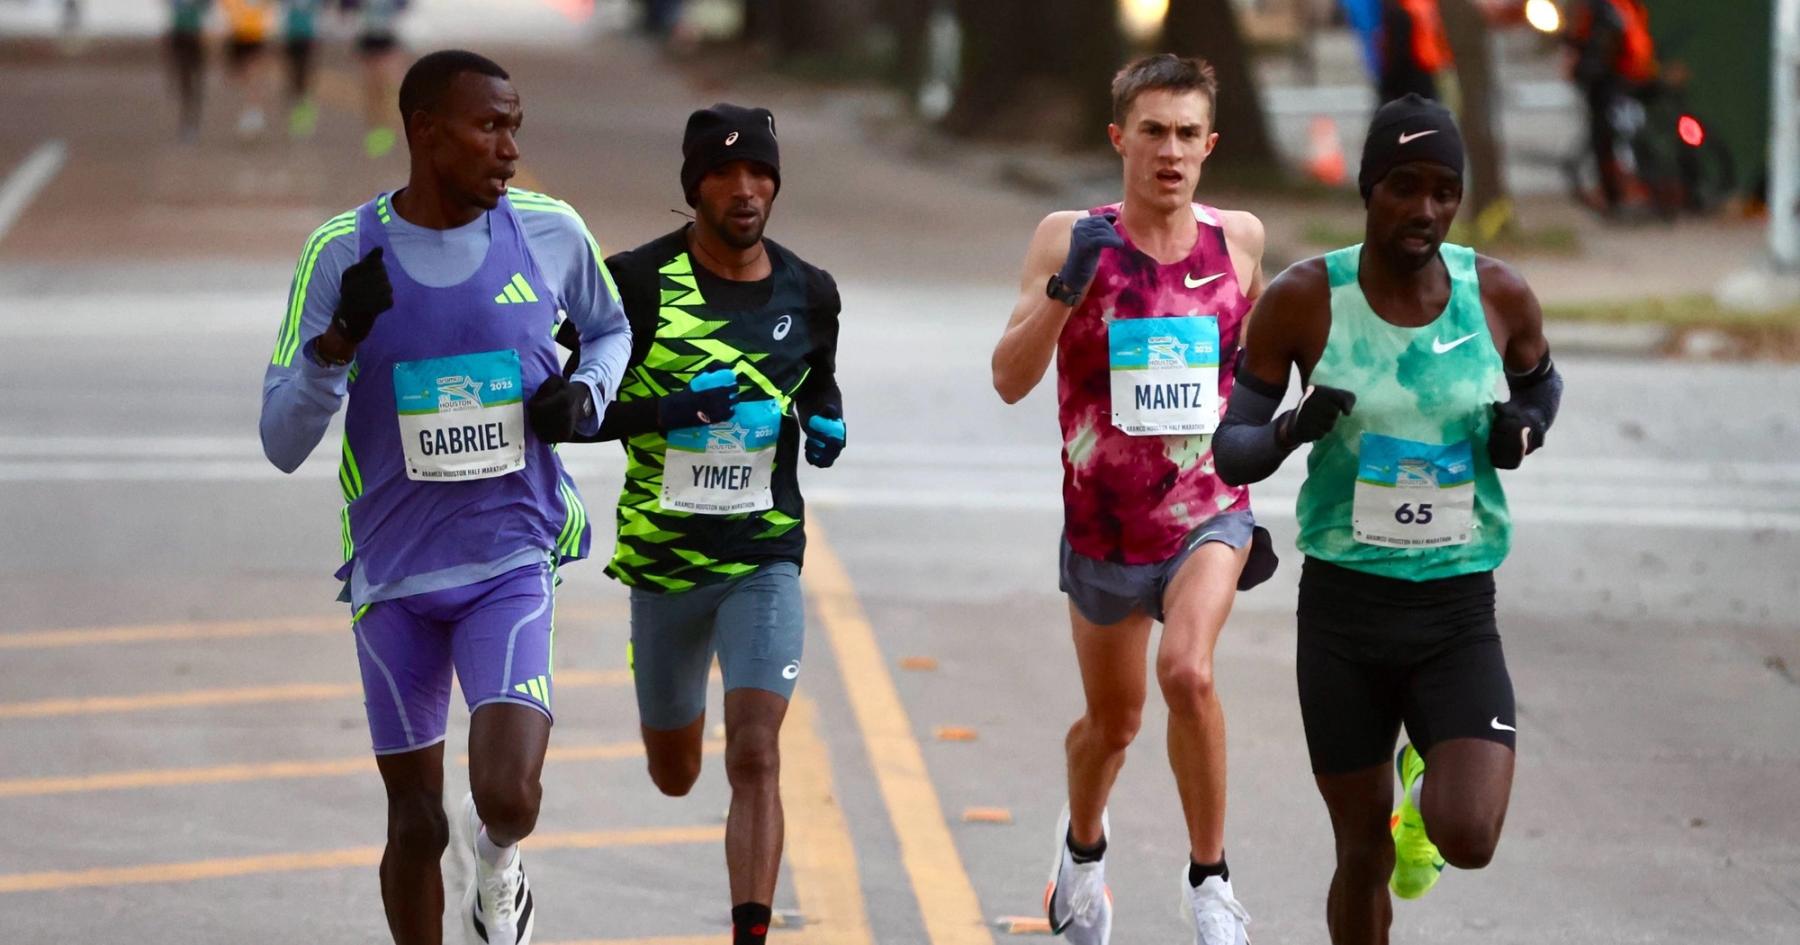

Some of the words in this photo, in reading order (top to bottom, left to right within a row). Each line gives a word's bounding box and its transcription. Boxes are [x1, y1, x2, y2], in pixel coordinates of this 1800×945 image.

[490, 381, 513, 392] 2025
[1135, 383, 1202, 410] MANTZ
[440, 400, 472, 409] HOUSTON
[419, 422, 510, 456] GABRIEL
[468, 468, 480, 476] HALF
[481, 464, 508, 475] MARATHON
[691, 464, 753, 490] YIMER
[1394, 502, 1433, 525] 65
